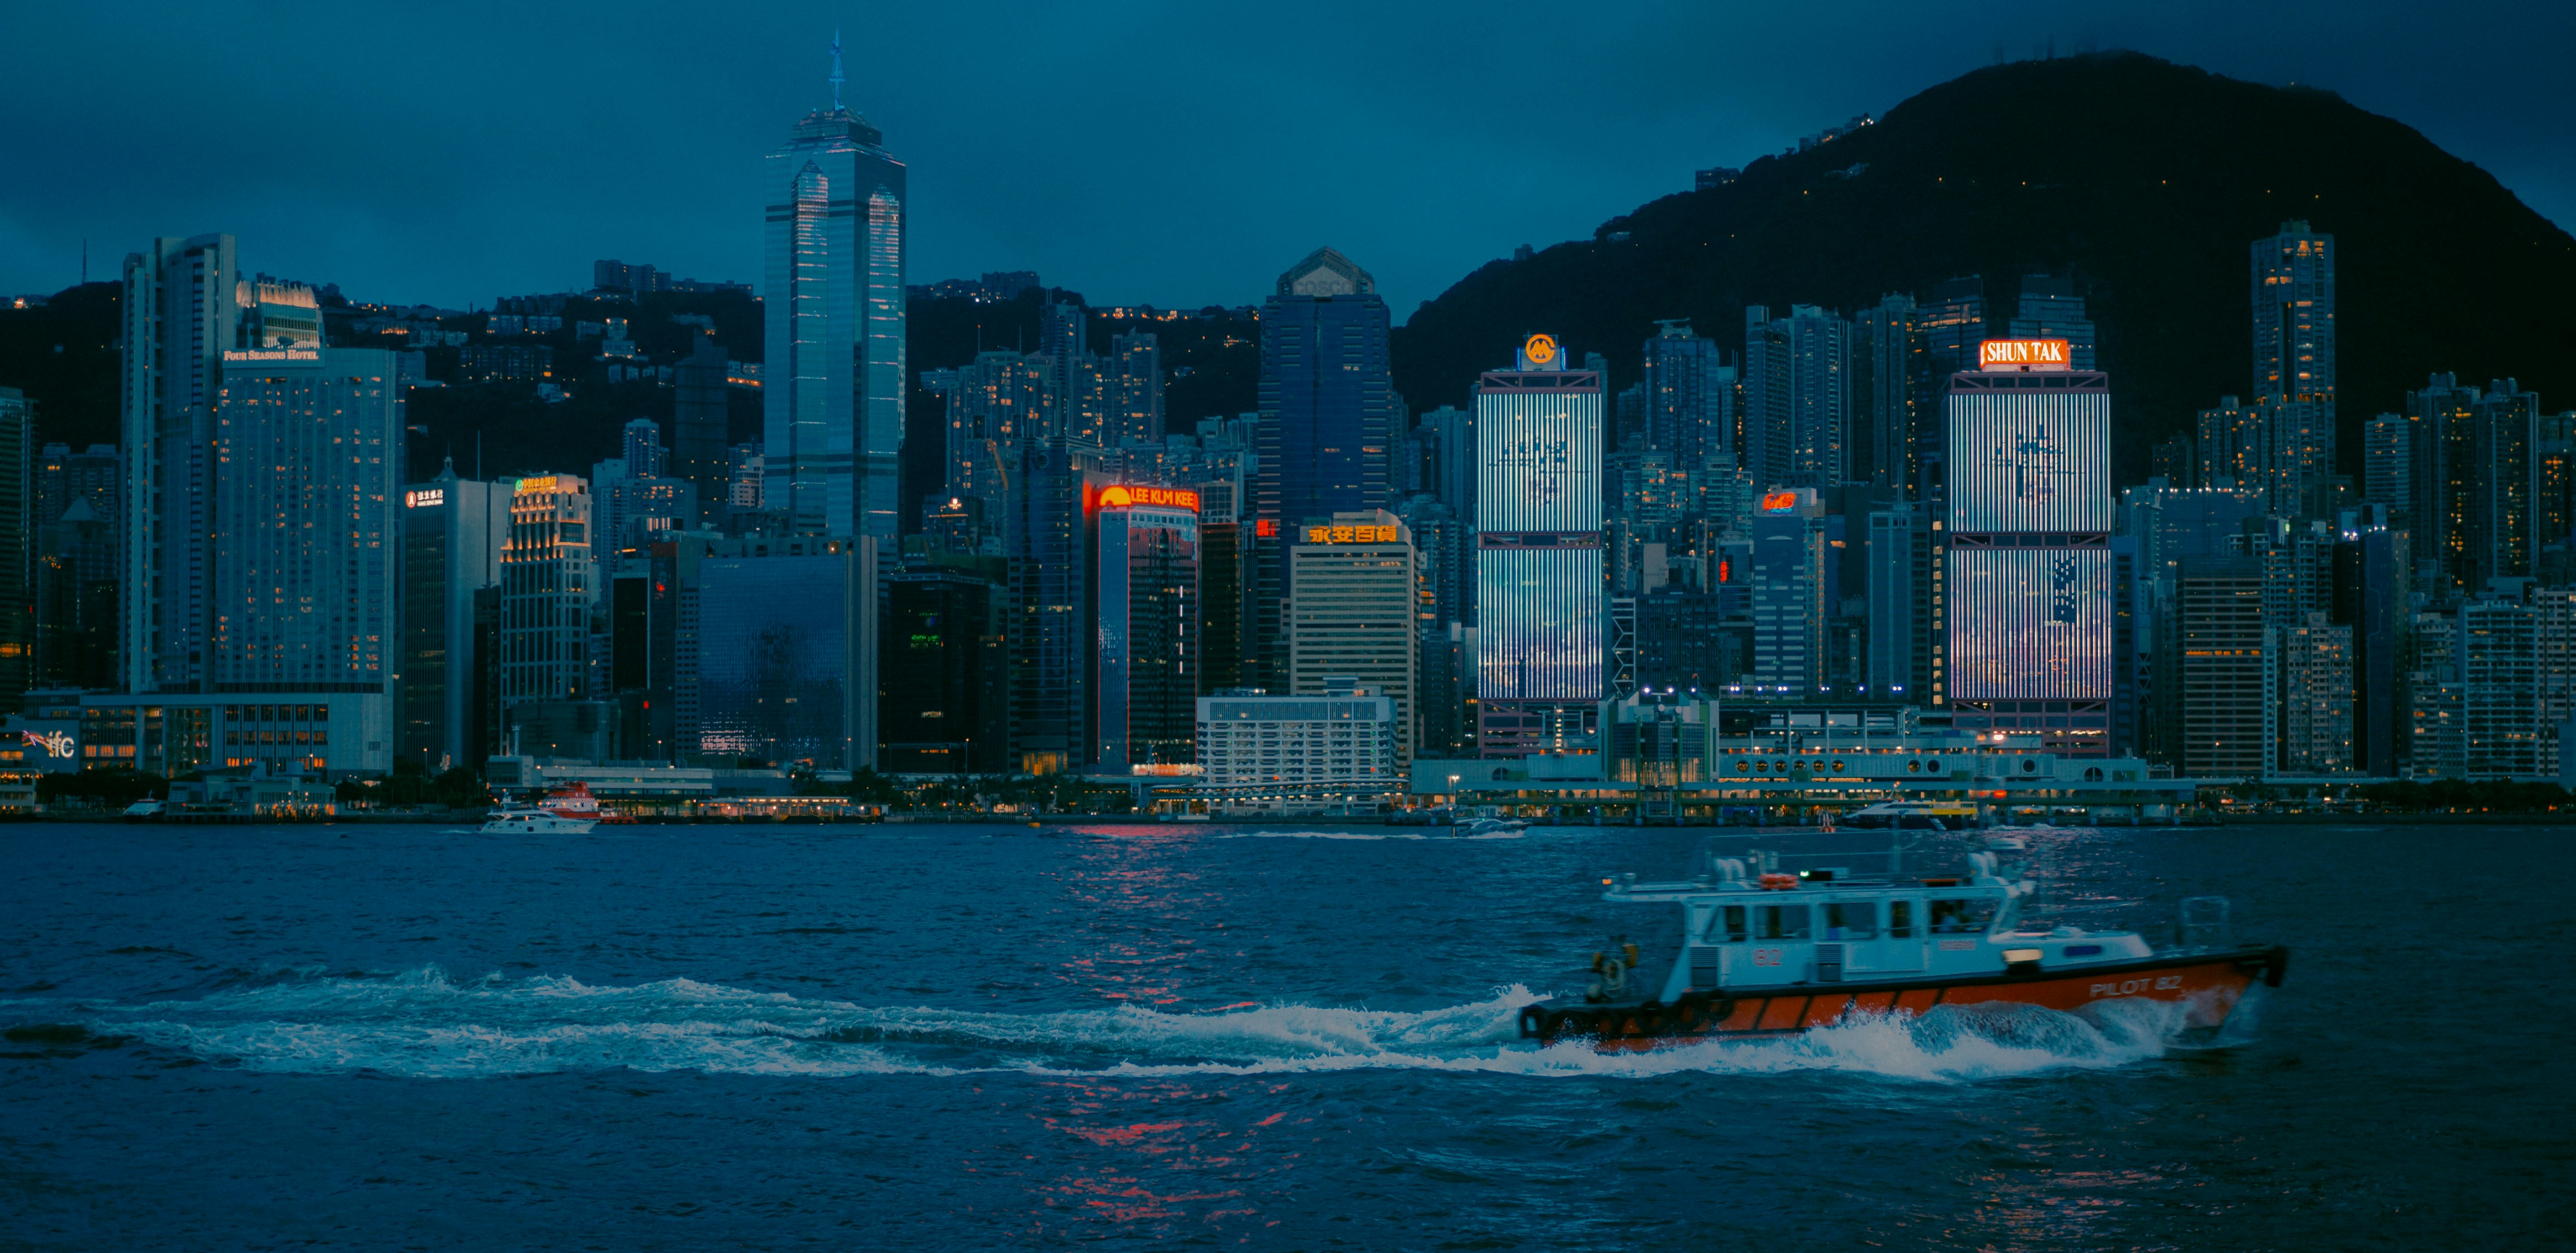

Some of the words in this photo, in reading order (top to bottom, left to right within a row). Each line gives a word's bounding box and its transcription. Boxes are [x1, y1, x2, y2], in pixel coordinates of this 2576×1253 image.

[1294, 281, 1353, 295] COSCO
[224, 350, 247, 360] FOUR
[248, 350, 286, 360] SEASONS
[287, 349, 318, 359] HOTEL
[1987, 342, 2027, 362] SHUN
[2031, 342, 2062, 361] TAK
[1130, 487, 1149, 503] LEE
[1150, 489, 1173, 505] KUM
[1175, 491, 1194, 507] KEE
[1309, 525, 1396, 543] 永安百貨
[49, 730, 74, 757] ifc
[1752, 949, 1783, 966] 82
[2090, 978, 2153, 997] PILOT
[2154, 975, 2182, 990] 82
